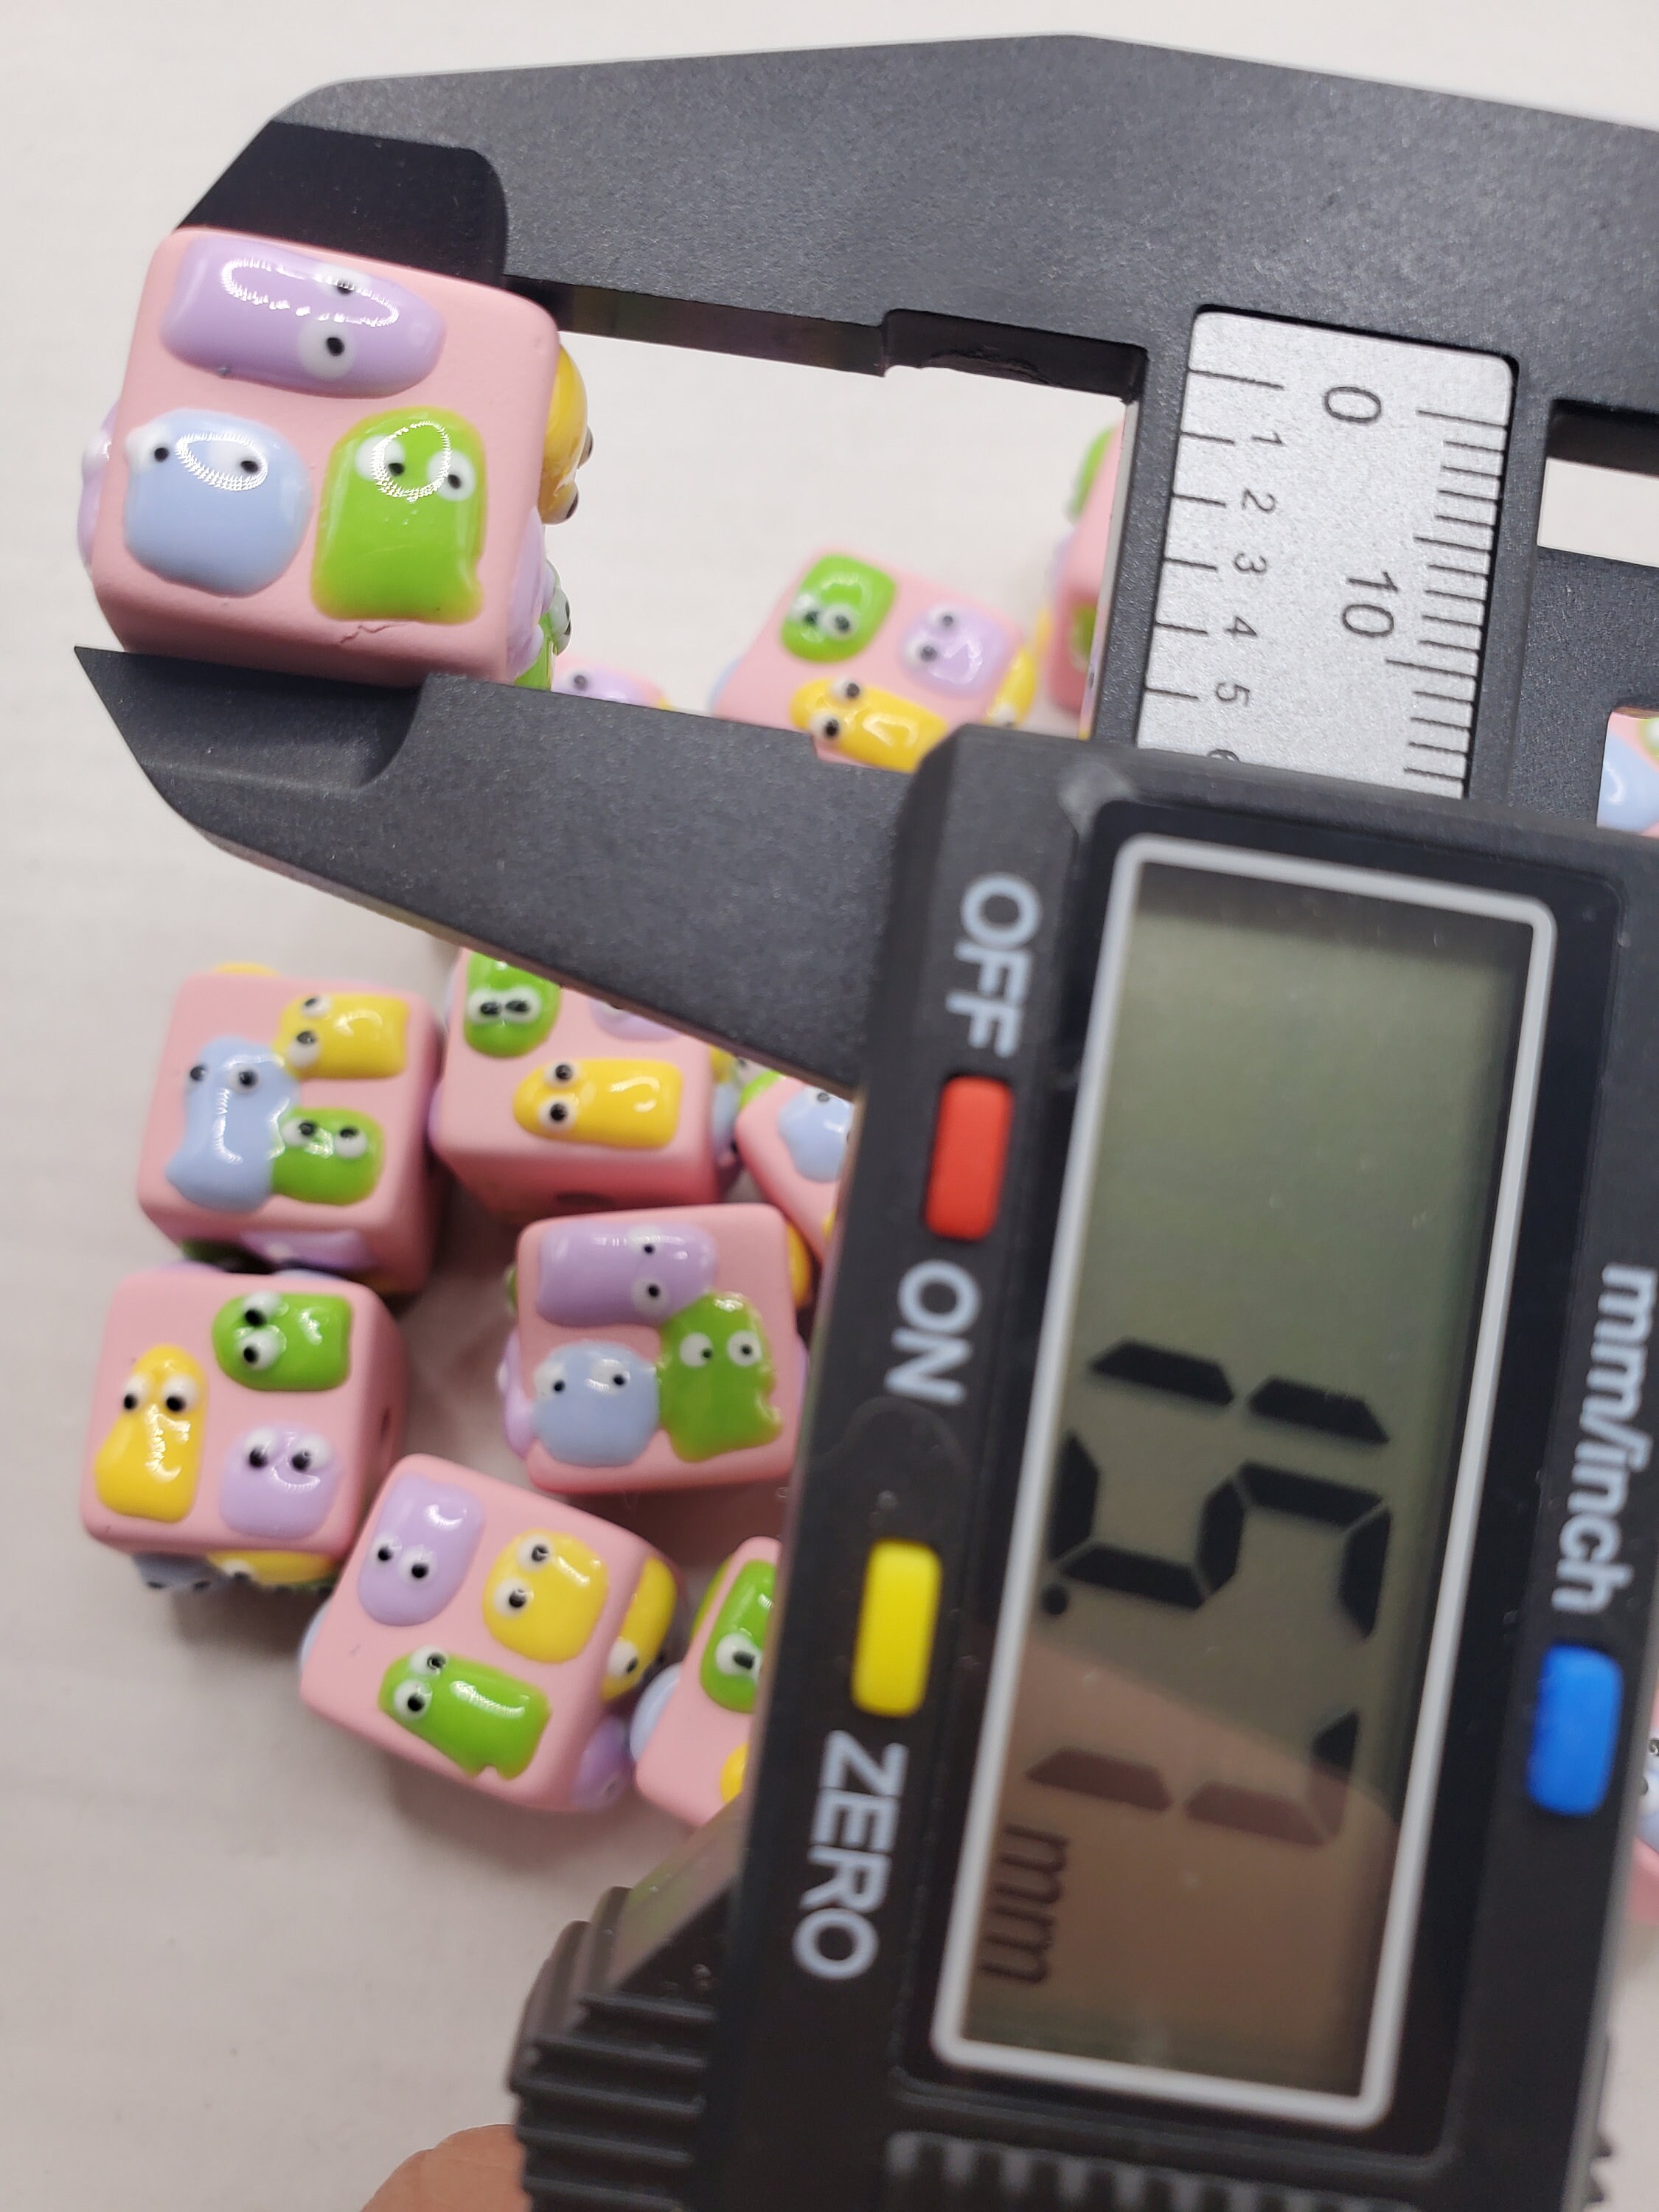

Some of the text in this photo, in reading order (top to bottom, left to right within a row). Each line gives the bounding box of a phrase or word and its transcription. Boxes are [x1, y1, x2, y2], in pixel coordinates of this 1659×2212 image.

[1214, 431, 1284, 705] 1 2 3 4 5
[1322, 386, 1400, 639] 0 10
[792, 873, 1042, 1980] OFF ON ZERO
[1550, 1264, 1657, 1615] mm/inch
[978, 1338, 1393, 1984] 15.7 mm
